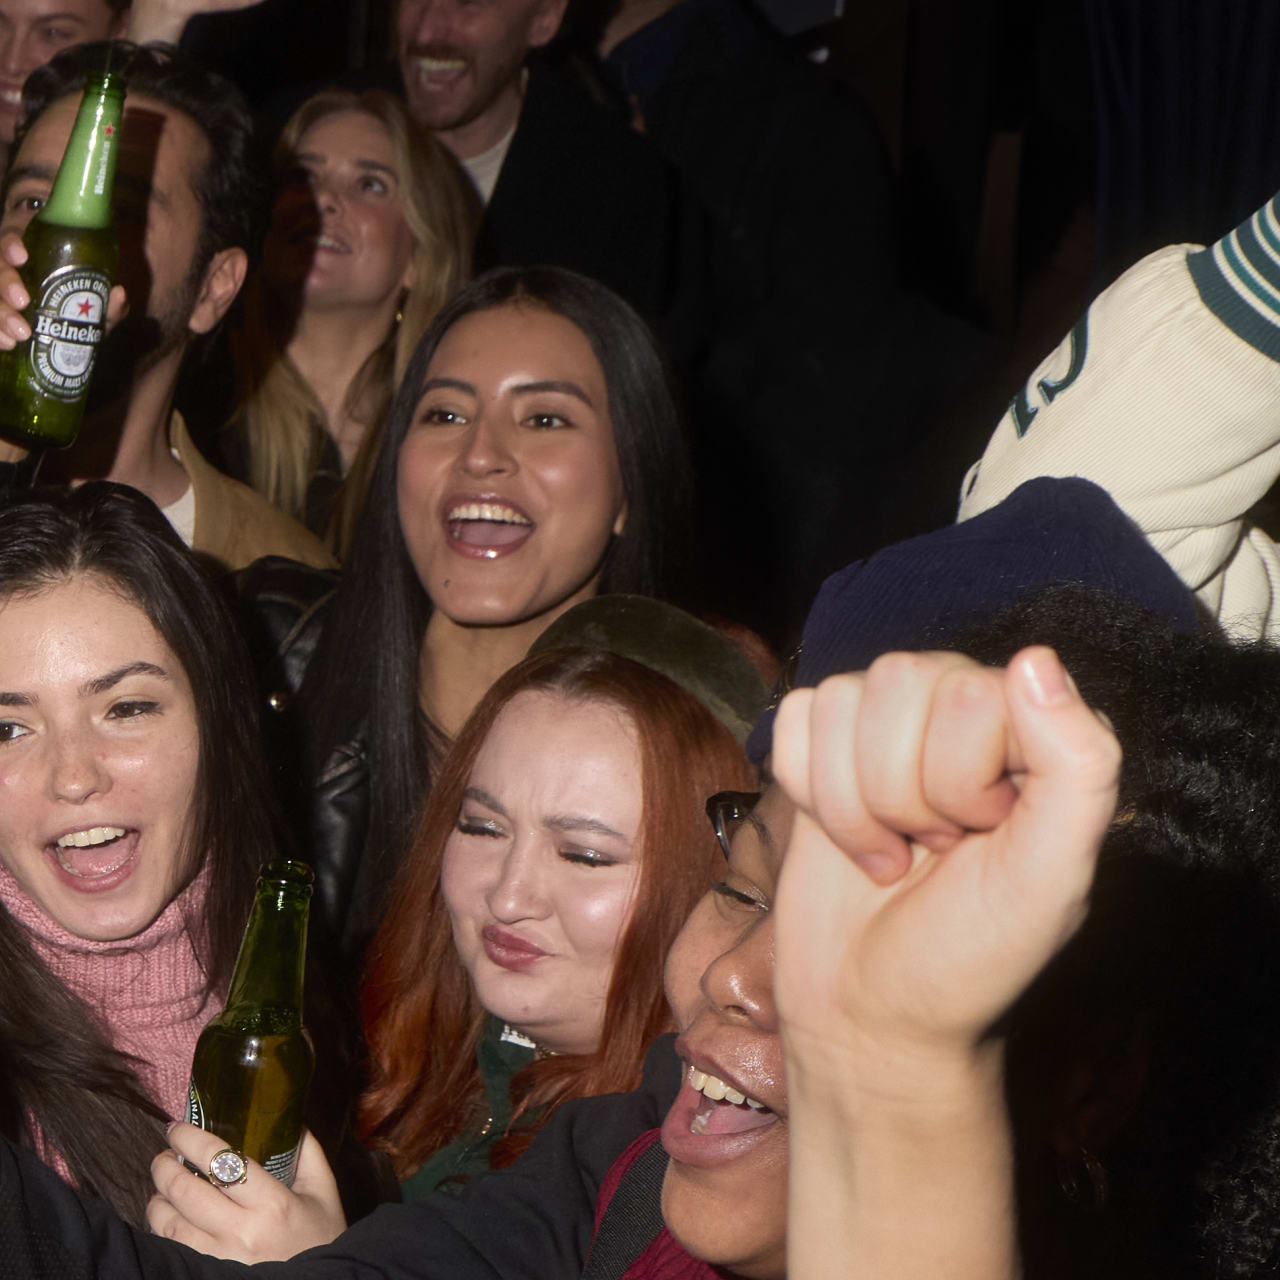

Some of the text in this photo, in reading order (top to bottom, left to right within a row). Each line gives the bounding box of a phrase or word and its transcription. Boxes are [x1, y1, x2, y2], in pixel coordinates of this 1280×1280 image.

[94, 141, 111, 196] Heineken
[49, 278, 92, 308] HEINEKEN
[37, 352, 65, 387] PREMIUM
[64, 376, 82, 389] MALT
